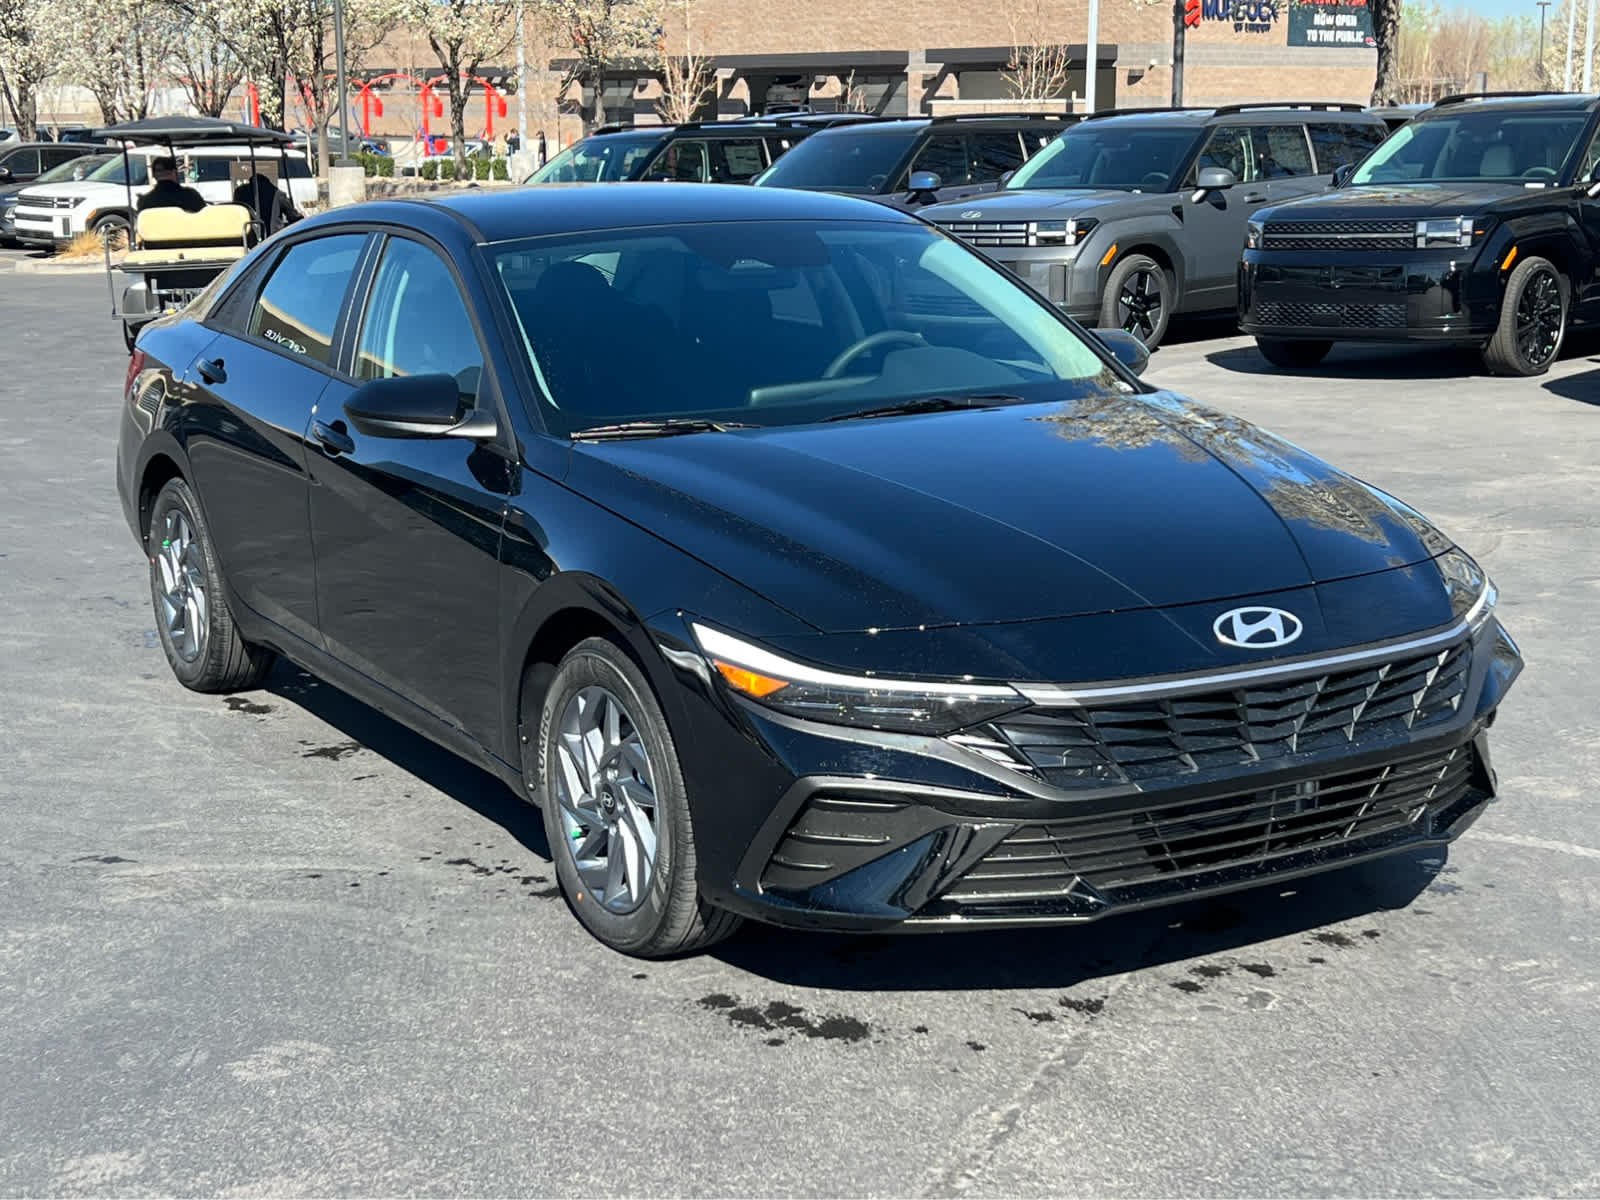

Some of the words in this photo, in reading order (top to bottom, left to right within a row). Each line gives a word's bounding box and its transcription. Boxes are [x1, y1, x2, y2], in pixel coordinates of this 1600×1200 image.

[1313, 13, 1335, 26] NOW
[1335, 14, 1357, 27] OPEN
[1306, 29, 1318, 42] TO
[1319, 30, 1335, 42] THE
[1336, 31, 1365, 43] PUBLIC
